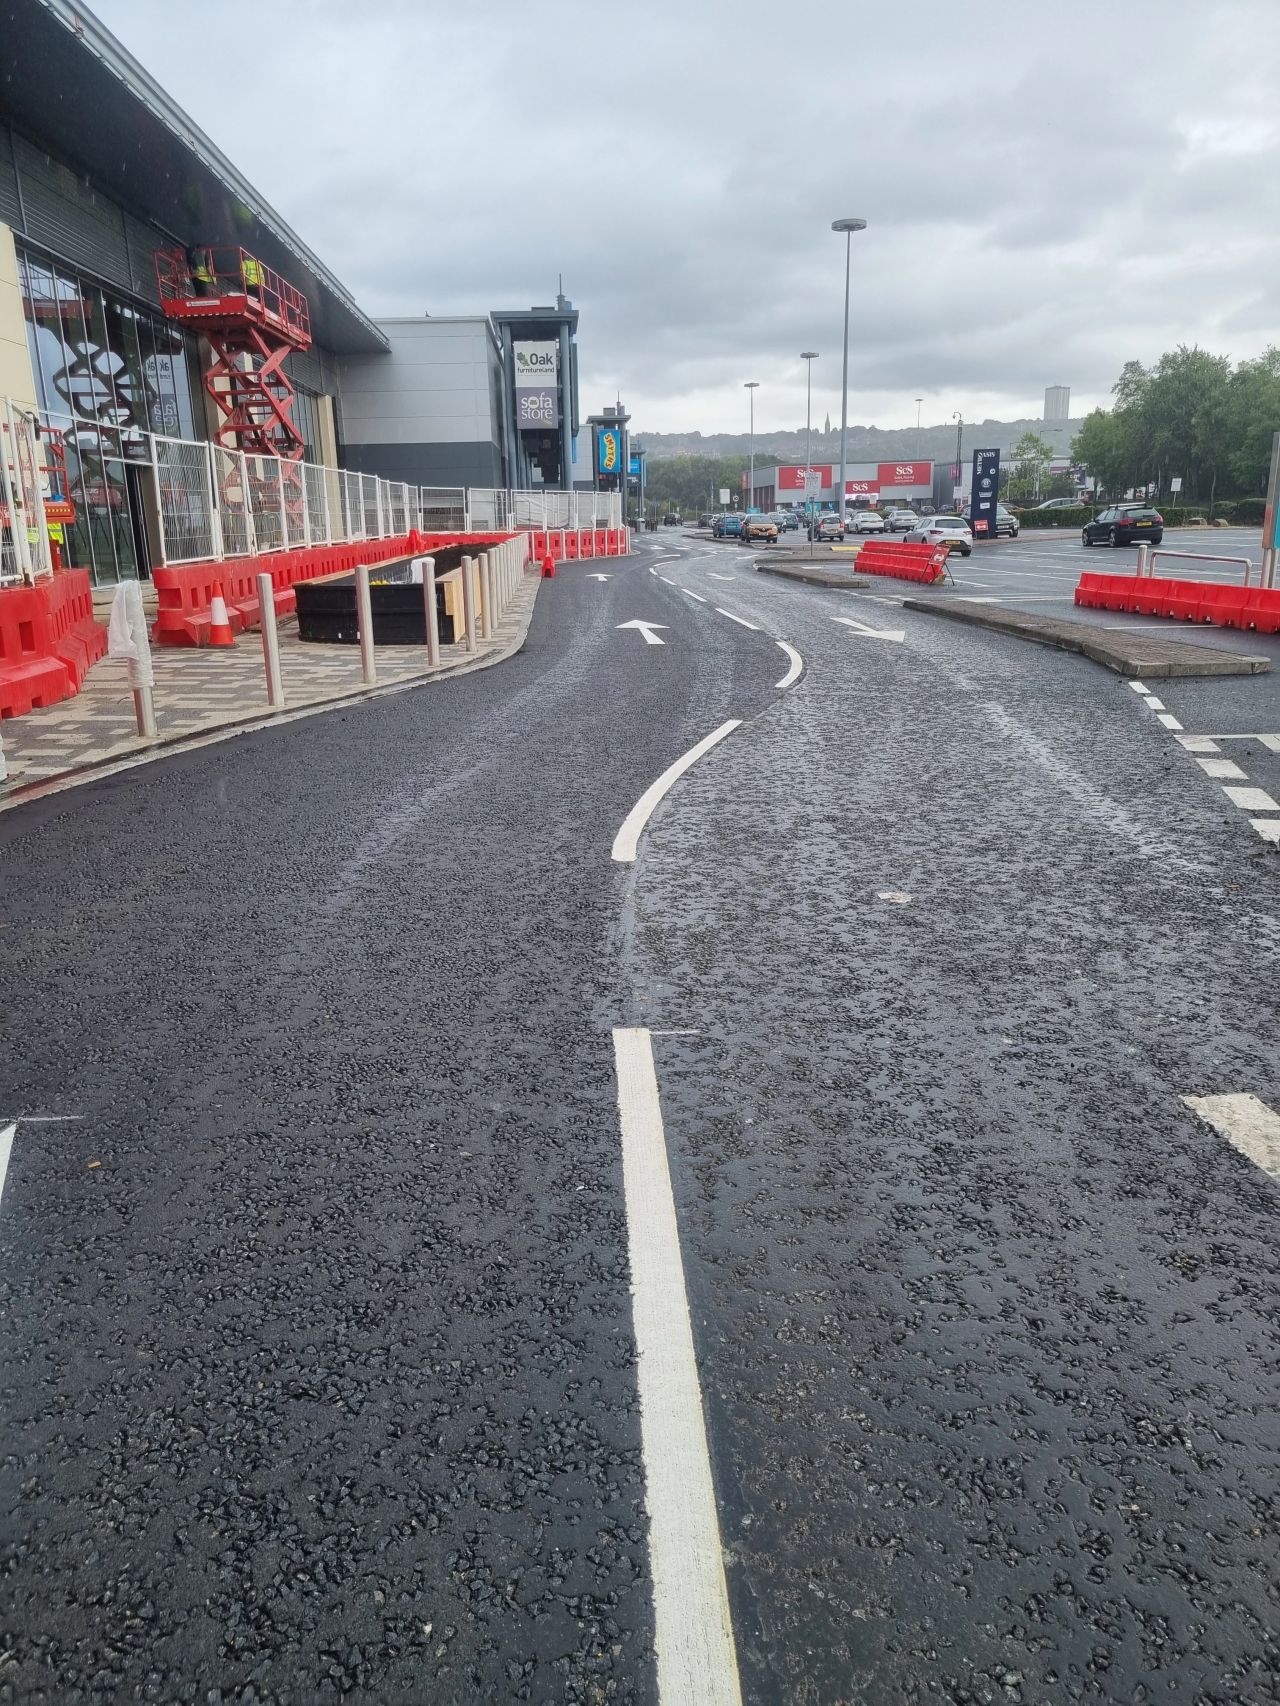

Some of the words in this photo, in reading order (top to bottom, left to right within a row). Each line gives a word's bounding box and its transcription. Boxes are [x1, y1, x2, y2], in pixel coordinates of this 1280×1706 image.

[530, 353, 553, 365] Oak
[521, 392, 552, 409] sofa
[521, 408, 552, 419] store
[604, 434, 615, 468] SMYTHS
[896, 466, 913, 475] ScS
[852, 483, 868, 491] ScS
